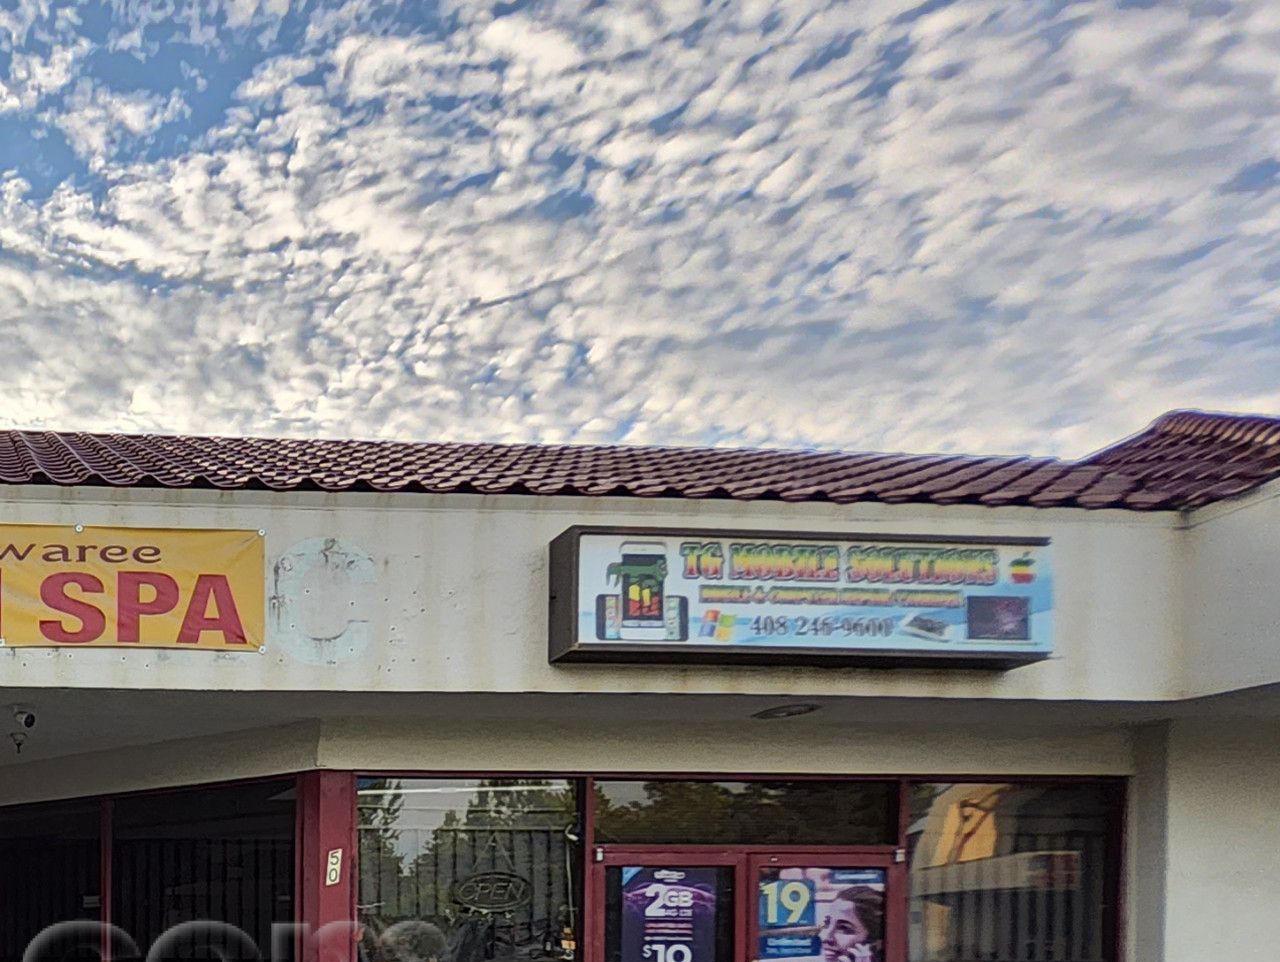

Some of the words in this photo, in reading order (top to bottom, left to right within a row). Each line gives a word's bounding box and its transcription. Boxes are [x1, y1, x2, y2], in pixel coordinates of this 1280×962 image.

[38, 570, 248, 644] SPA
[749, 615, 788, 636] 408
[328, 850, 340, 883] 50
[459, 881, 527, 901] OPEN
